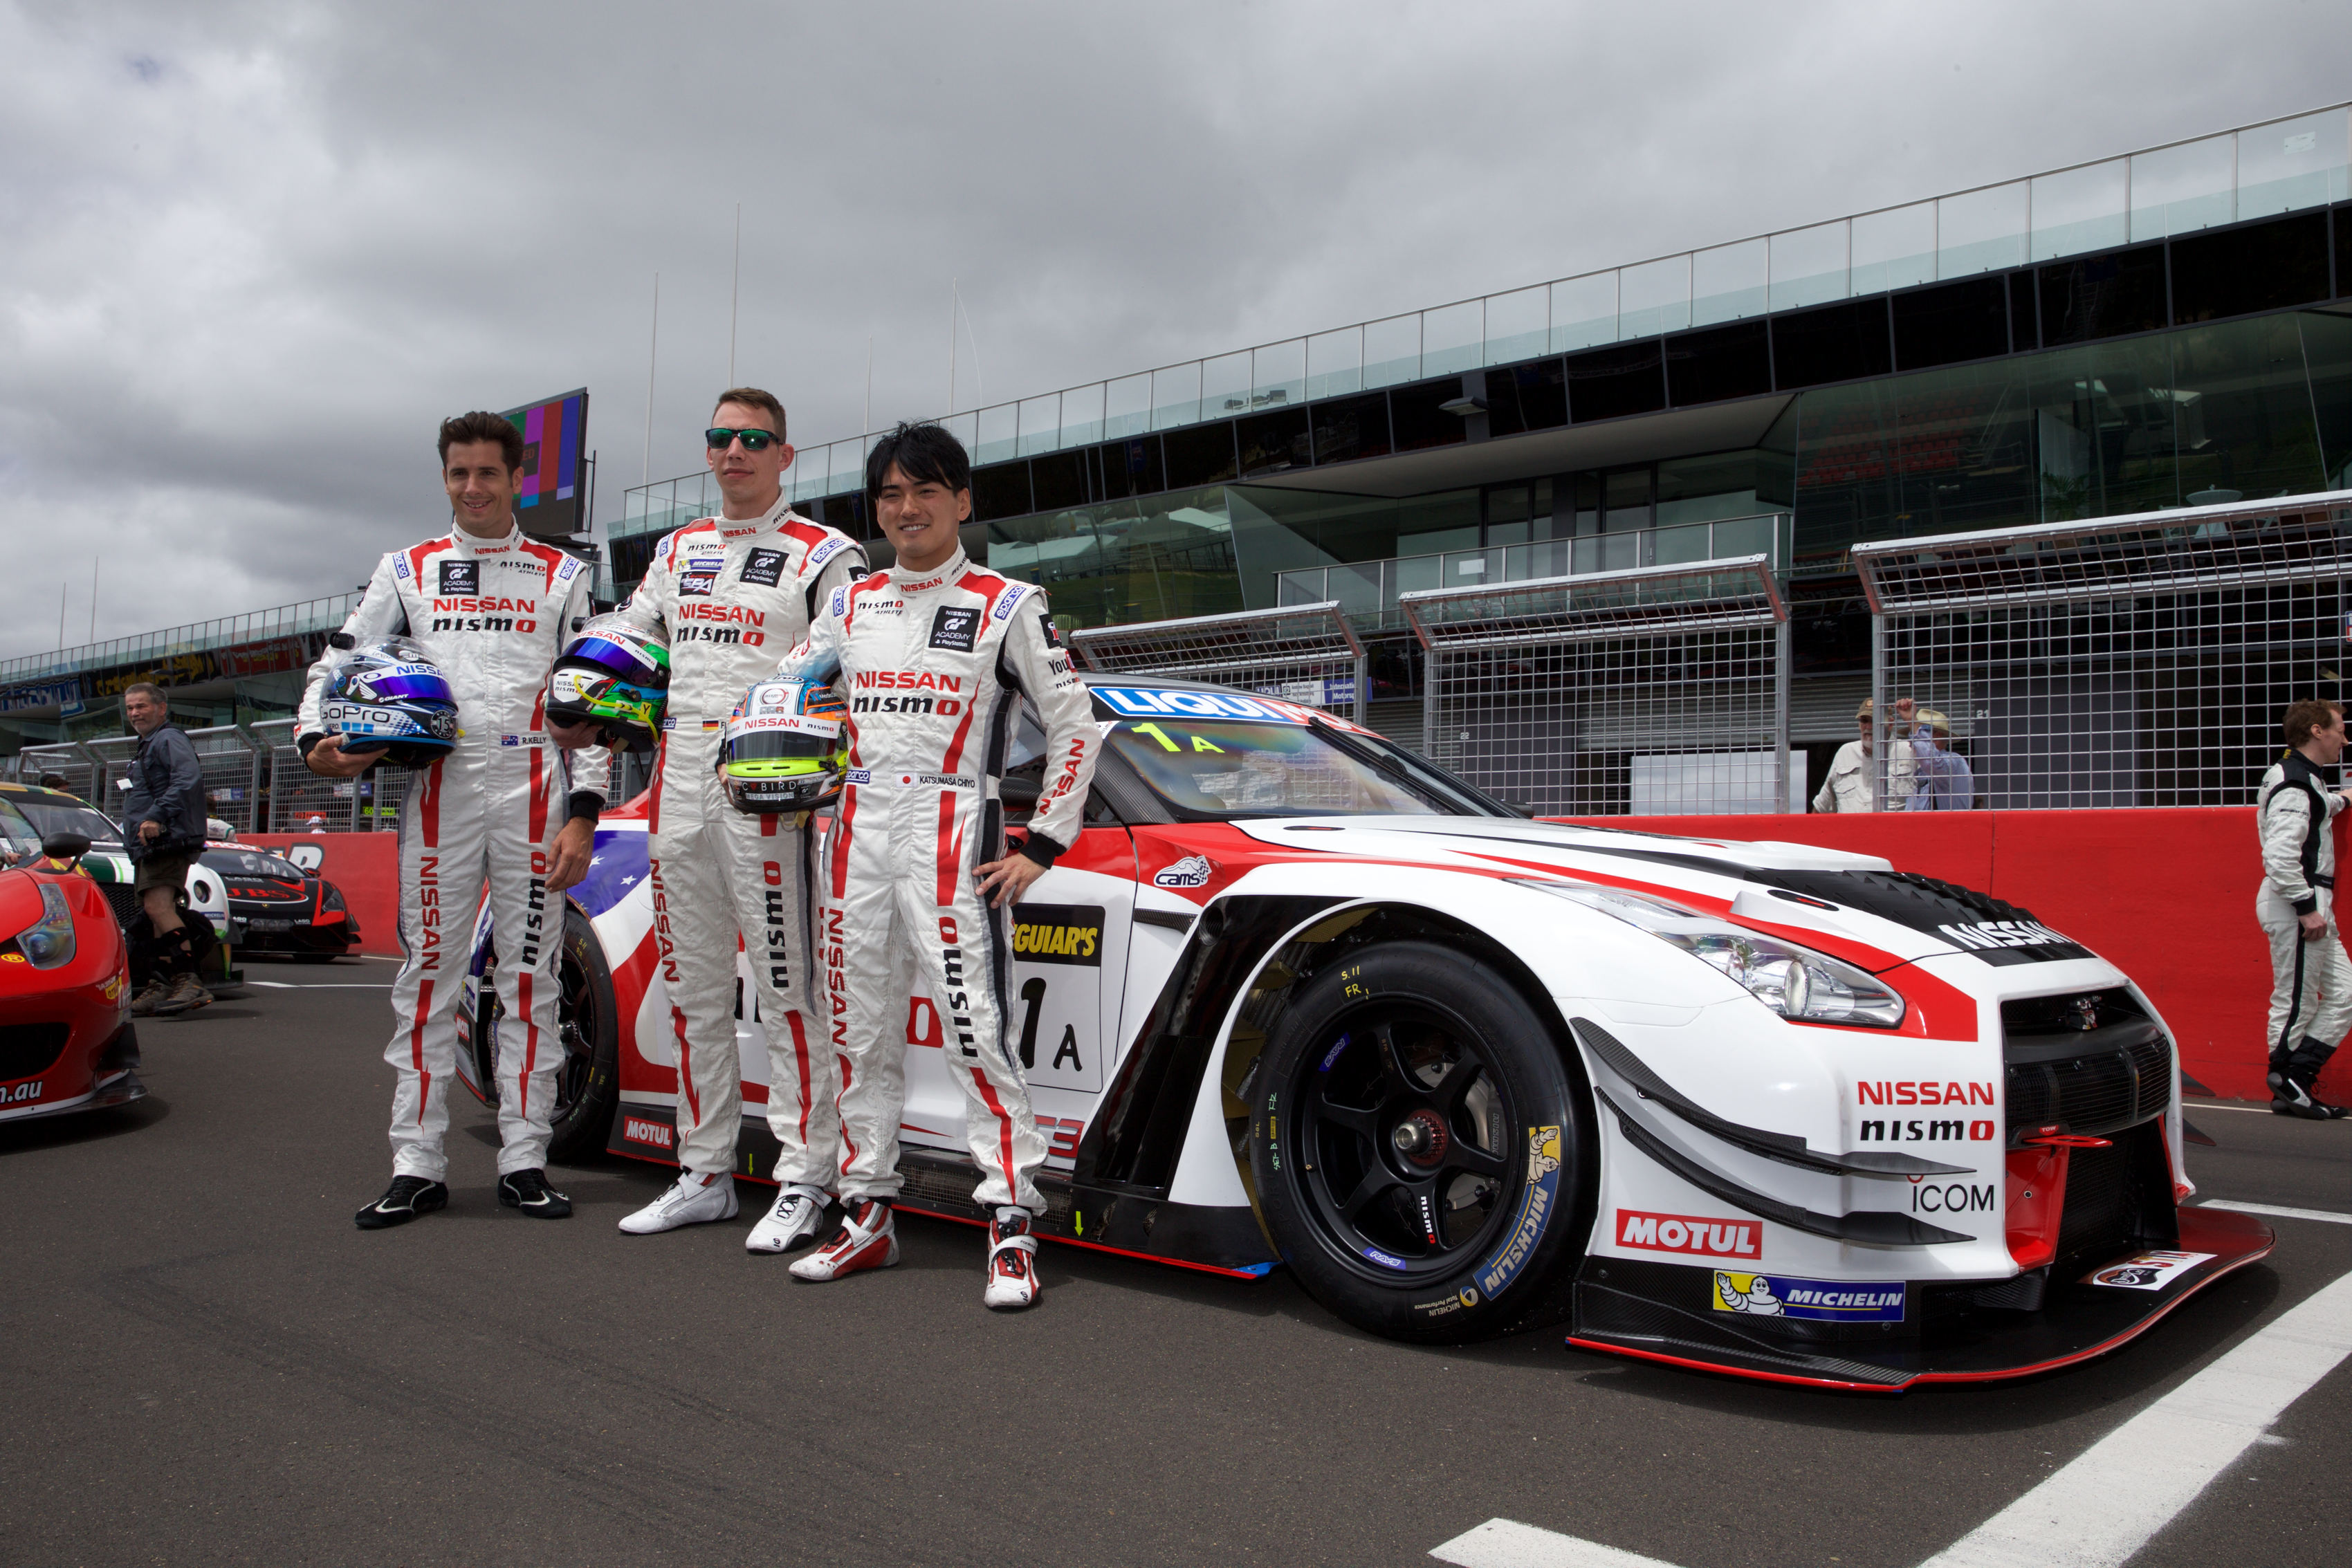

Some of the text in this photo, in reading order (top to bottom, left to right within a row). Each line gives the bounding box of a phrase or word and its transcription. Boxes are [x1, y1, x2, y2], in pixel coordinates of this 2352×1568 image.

[722, 526, 756, 537] NISSAN
[475, 545, 511, 555] NISSAN
[687, 544, 727, 552] nismo
[812, 538, 843, 563] sparco
[500, 561, 546, 572] nismo
[746, 568, 777, 577] ACADEMY
[751, 575, 773, 583] PlayStation
[900, 577, 943, 593] NISSAN
[433, 596, 535, 614] NISSAN
[858, 600, 903, 610] nismo
[996, 585, 1024, 618] sparco
[679, 603, 765, 627] NISSAN
[432, 617, 536, 633] nismo
[577, 630, 625, 645] NISSAN
[676, 627, 764, 647] nismo
[935, 631, 971, 640] ACADEMY
[941, 639, 968, 647] PlayStation
[634, 648, 656, 665] nismo
[856, 671, 961, 692] NISSAN
[643, 704, 651, 715] Y
[852, 696, 961, 716] nismo
[1105, 689, 1283, 719] LIQUI
[320, 705, 390, 723] GoPro
[438, 717, 450, 732] 15
[744, 718, 800, 729] NISSAN
[807, 723, 834, 732] nismo
[522, 737, 546, 745] R.KELLY
[1131, 722, 1182, 752] 1
[1191, 736, 1225, 753] A
[761, 781, 797, 791] BIRD
[919, 775, 975, 788] KATSUMASA CHIYO
[766, 792, 794, 800] VISION
[420, 856, 441, 970] NISSAN
[522, 851, 546, 966] nismo
[650, 859, 680, 982] NISSAN
[763, 860, 789, 988] nismo
[1013, 923, 1098, 957] GUIAR'S
[1938, 921, 2073, 950] NISSAN
[828, 908, 847, 1046] NISSAN
[938, 916, 979, 1058] nismo
[1345, 983, 1362, 998] FR
[1019, 977, 1083, 1071] 1 A
[1857, 1081, 1994, 1106] NISSAN
[626, 1120, 671, 1146] MOTUL
[1859, 1120, 1995, 1141] nismo
[1420, 1196, 1436, 1244] nismo
[1485, 1186, 1549, 1292] MICHELIN
[1622, 1217, 1755, 1254] MOTUL
[1368, 1250, 1402, 1267] RAYS
[1414, 1295, 1459, 1310] Total Performance
[1786, 1289, 1903, 1307] MICHELIN
[1428, 1302, 1461, 1317] MICHELIN
